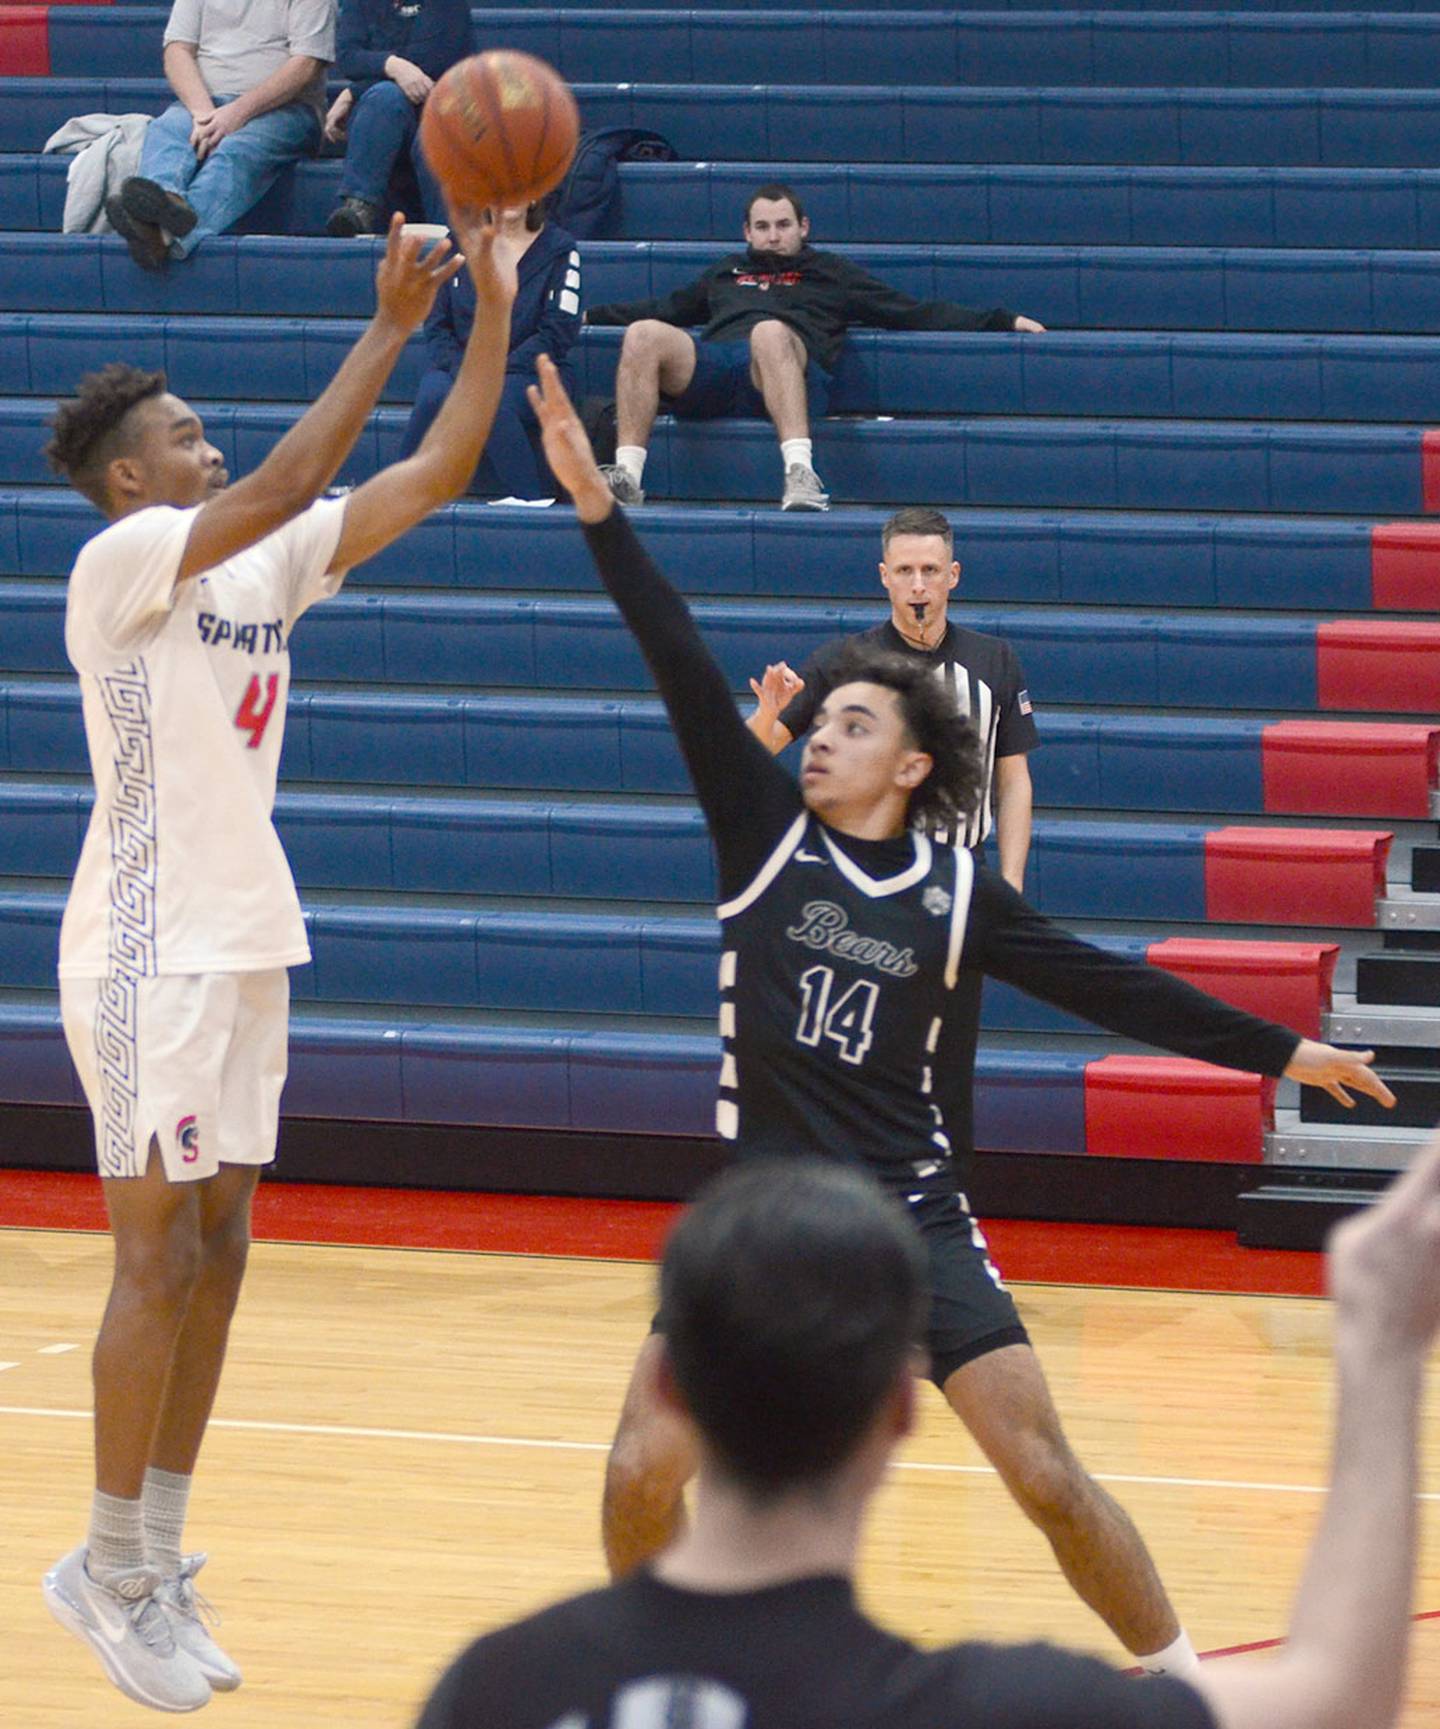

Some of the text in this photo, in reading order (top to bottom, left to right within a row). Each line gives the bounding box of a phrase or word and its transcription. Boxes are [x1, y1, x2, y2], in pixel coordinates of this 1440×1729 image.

[234, 671, 280, 750] 4
[786, 900, 919, 978] Bears
[795, 964, 881, 1066] 14
